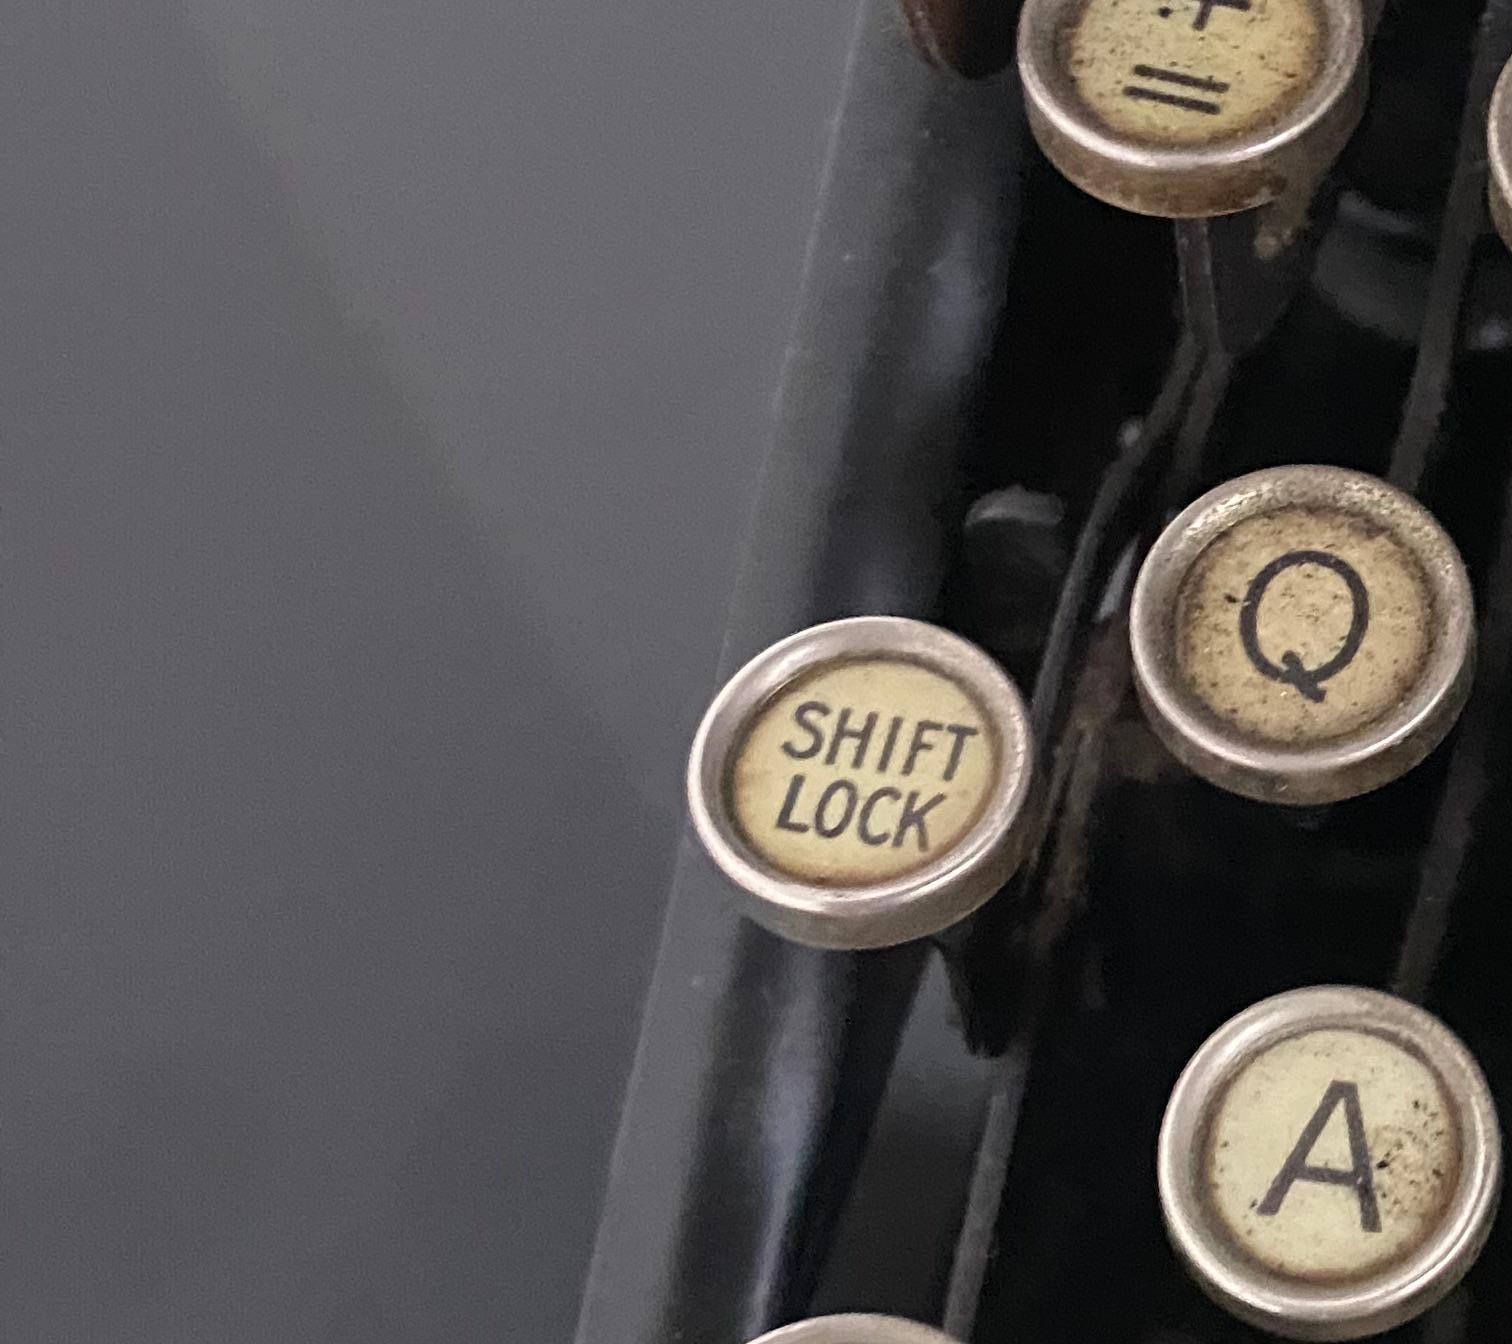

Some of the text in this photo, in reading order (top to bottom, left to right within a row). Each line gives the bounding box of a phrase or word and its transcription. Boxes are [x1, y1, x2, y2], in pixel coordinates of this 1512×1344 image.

[1239, 549, 1371, 703] Q
[780, 699, 979, 783] SHIFT
[775, 773, 947, 853] LOCK
[1256, 1079, 1383, 1233] A
